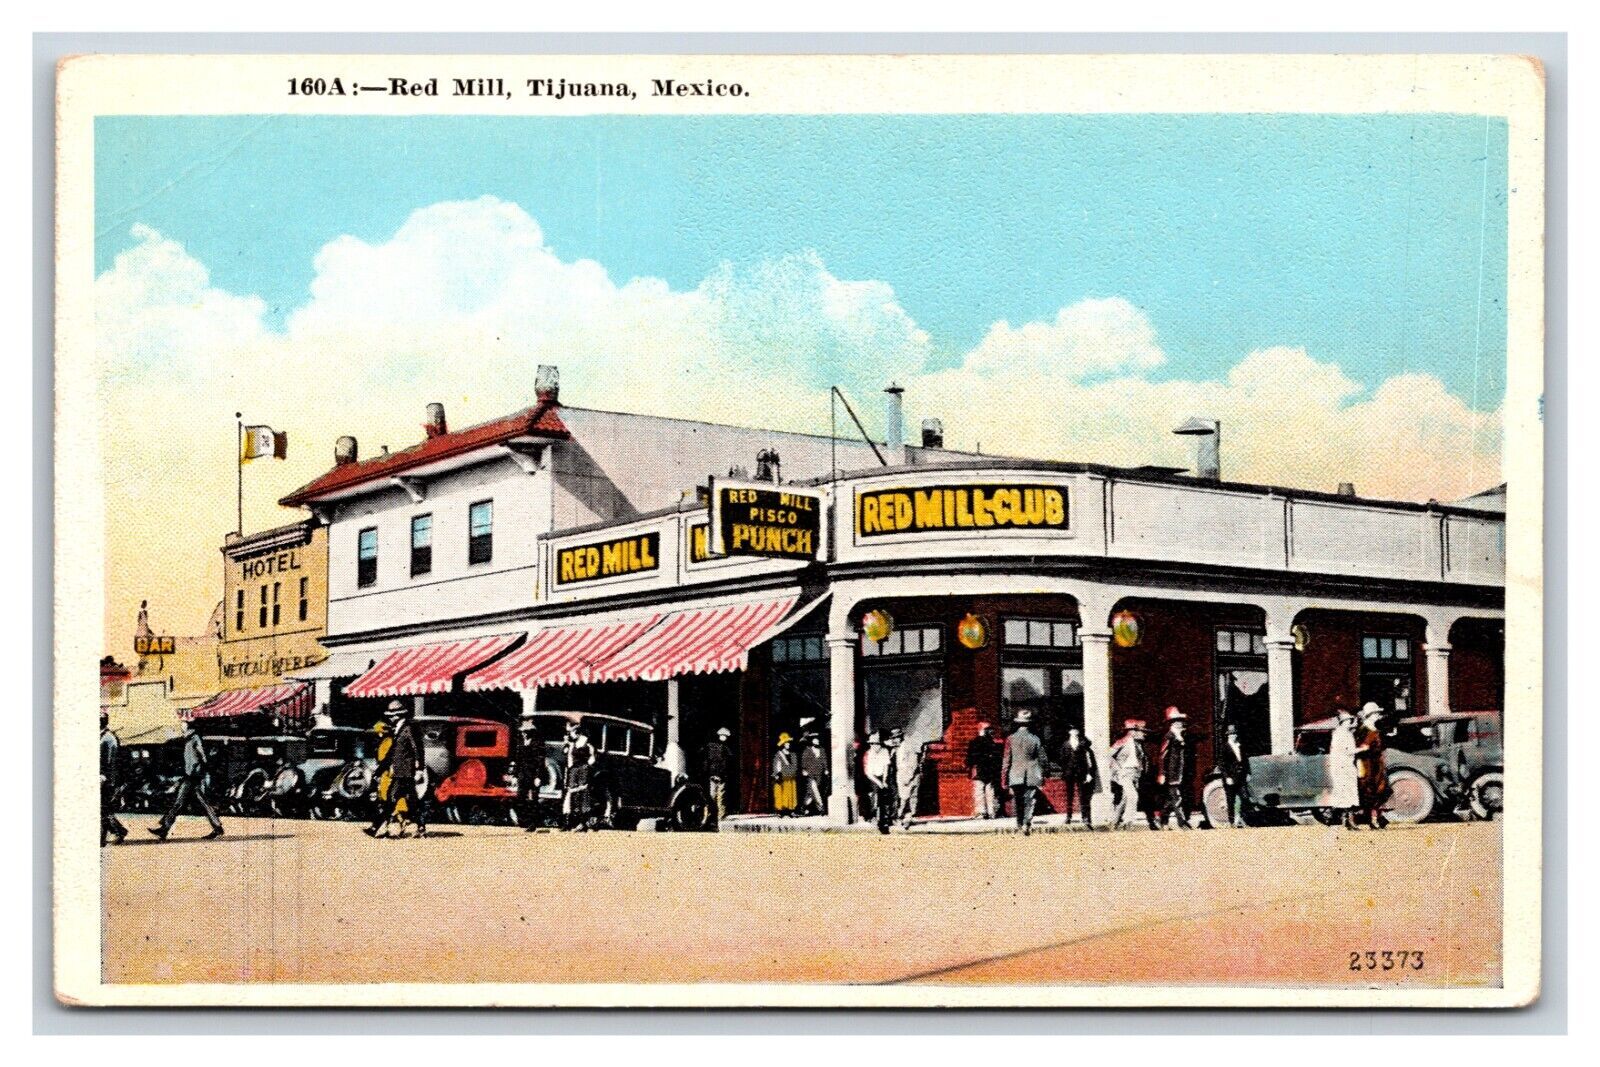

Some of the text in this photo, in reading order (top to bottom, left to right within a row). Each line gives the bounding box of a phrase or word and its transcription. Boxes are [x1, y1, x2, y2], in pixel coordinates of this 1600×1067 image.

[728, 488, 813, 512] RED MILL
[863, 492, 914, 534] RED
[732, 522, 814, 555] PUNCH
[242, 551, 301, 580] HOTEL
[561, 547, 600, 583] RED
[602, 537, 656, 576] MILL
[136, 638, 173, 652] BAR
